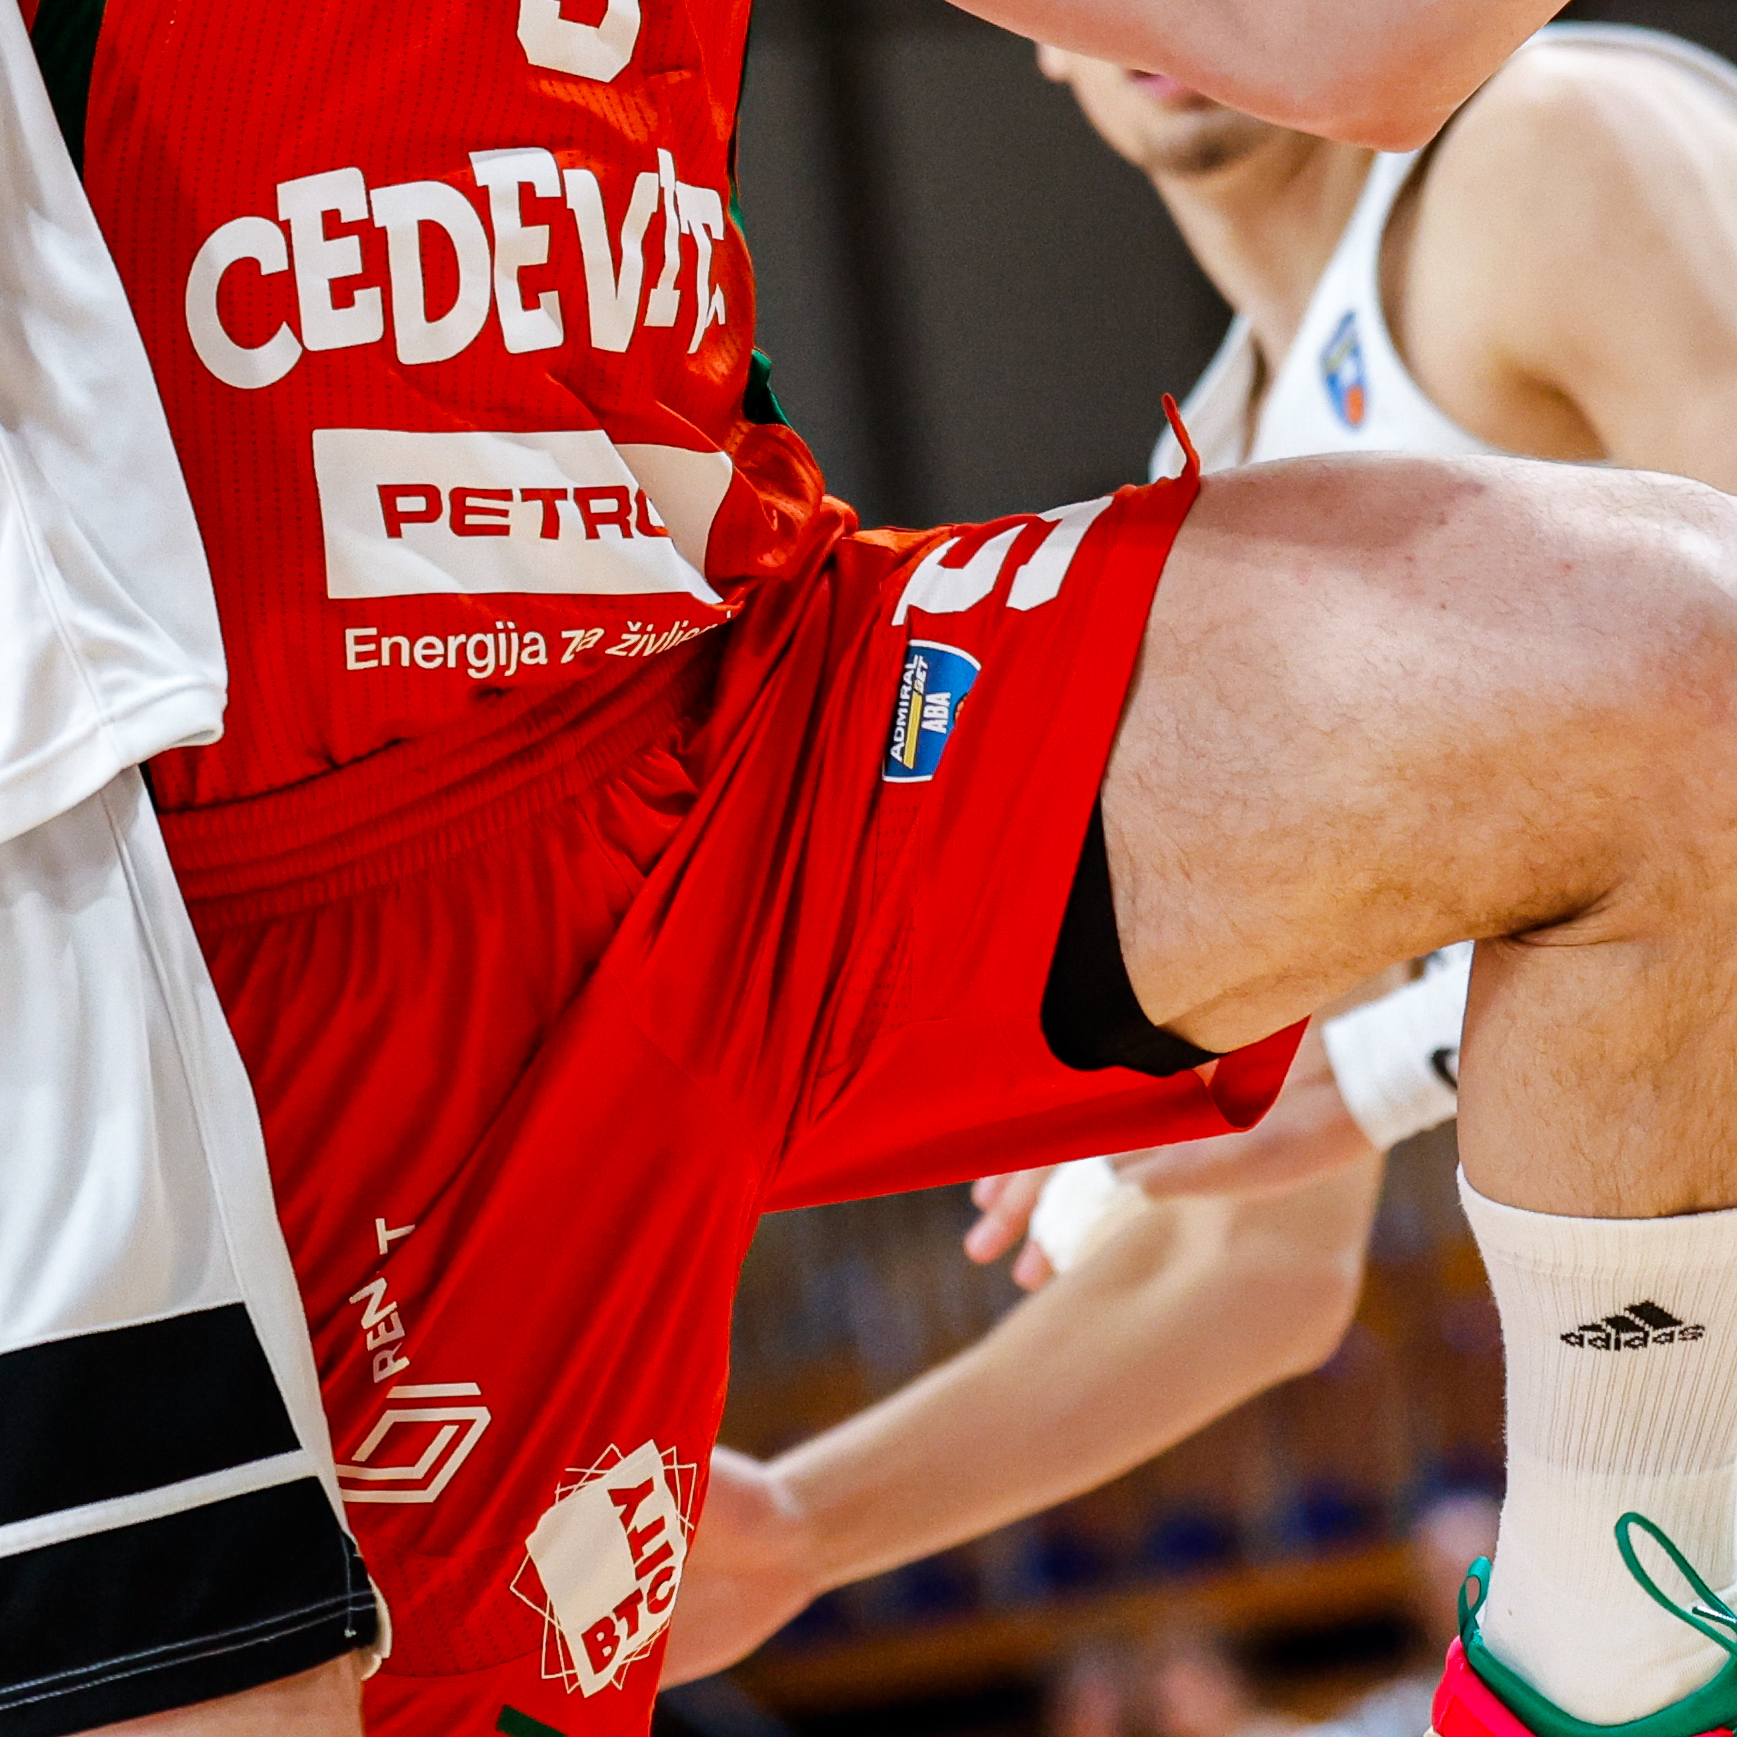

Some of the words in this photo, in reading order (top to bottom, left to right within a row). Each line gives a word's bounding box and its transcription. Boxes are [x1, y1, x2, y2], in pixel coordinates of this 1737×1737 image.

[184, 146, 726, 390] CEDEVIT
[344, 620, 548, 680] Energija
[913, 655, 929, 694] BET
[890, 654, 919, 762] ADMIRAL
[921, 691, 952, 735] ABA
[1560, 1323, 1706, 1352] adidas
